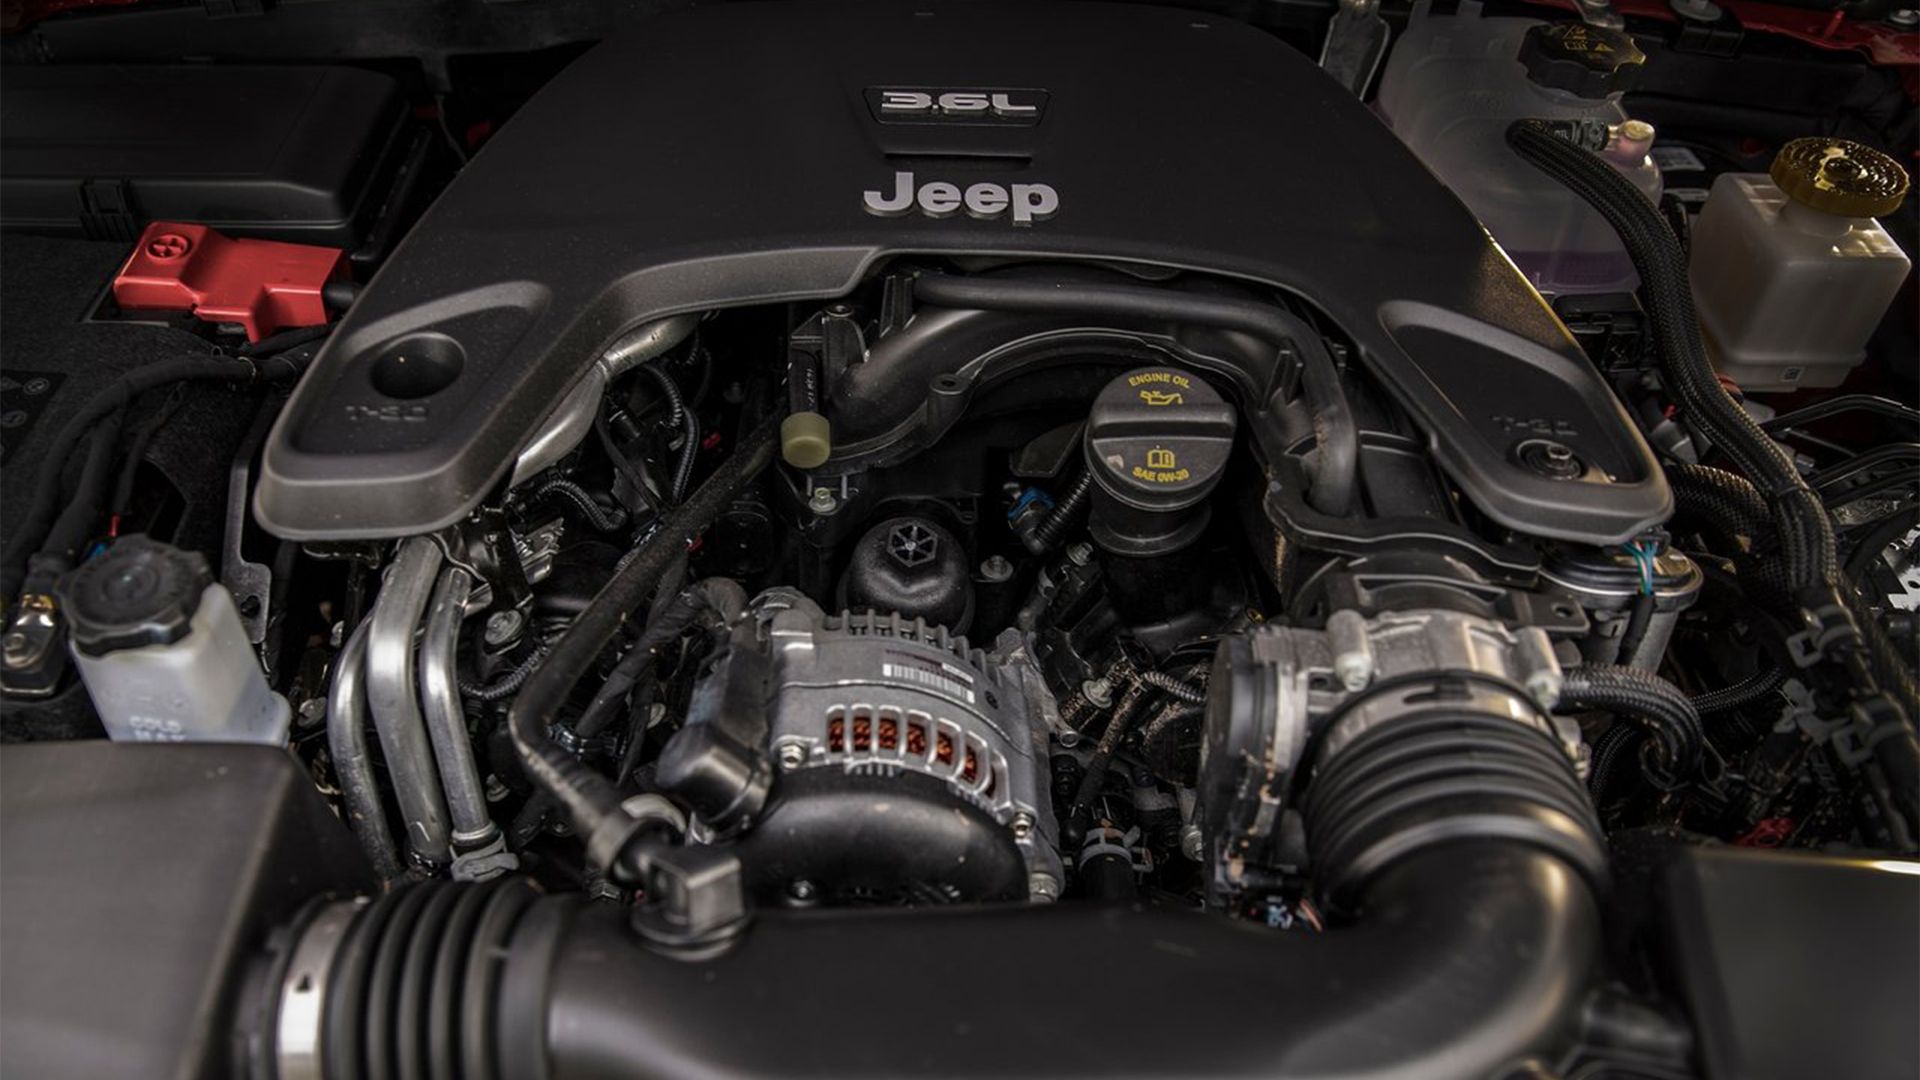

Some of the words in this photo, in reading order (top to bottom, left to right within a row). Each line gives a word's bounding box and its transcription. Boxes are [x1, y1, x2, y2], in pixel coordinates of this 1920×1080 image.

[881, 92, 1037, 114] 3.6L
[863, 171, 1060, 225] Jeep
[1128, 372, 1171, 387] ENGINE
[1172, 375, 1190, 389] OIL
[1132, 466, 1156, 481] SAE
